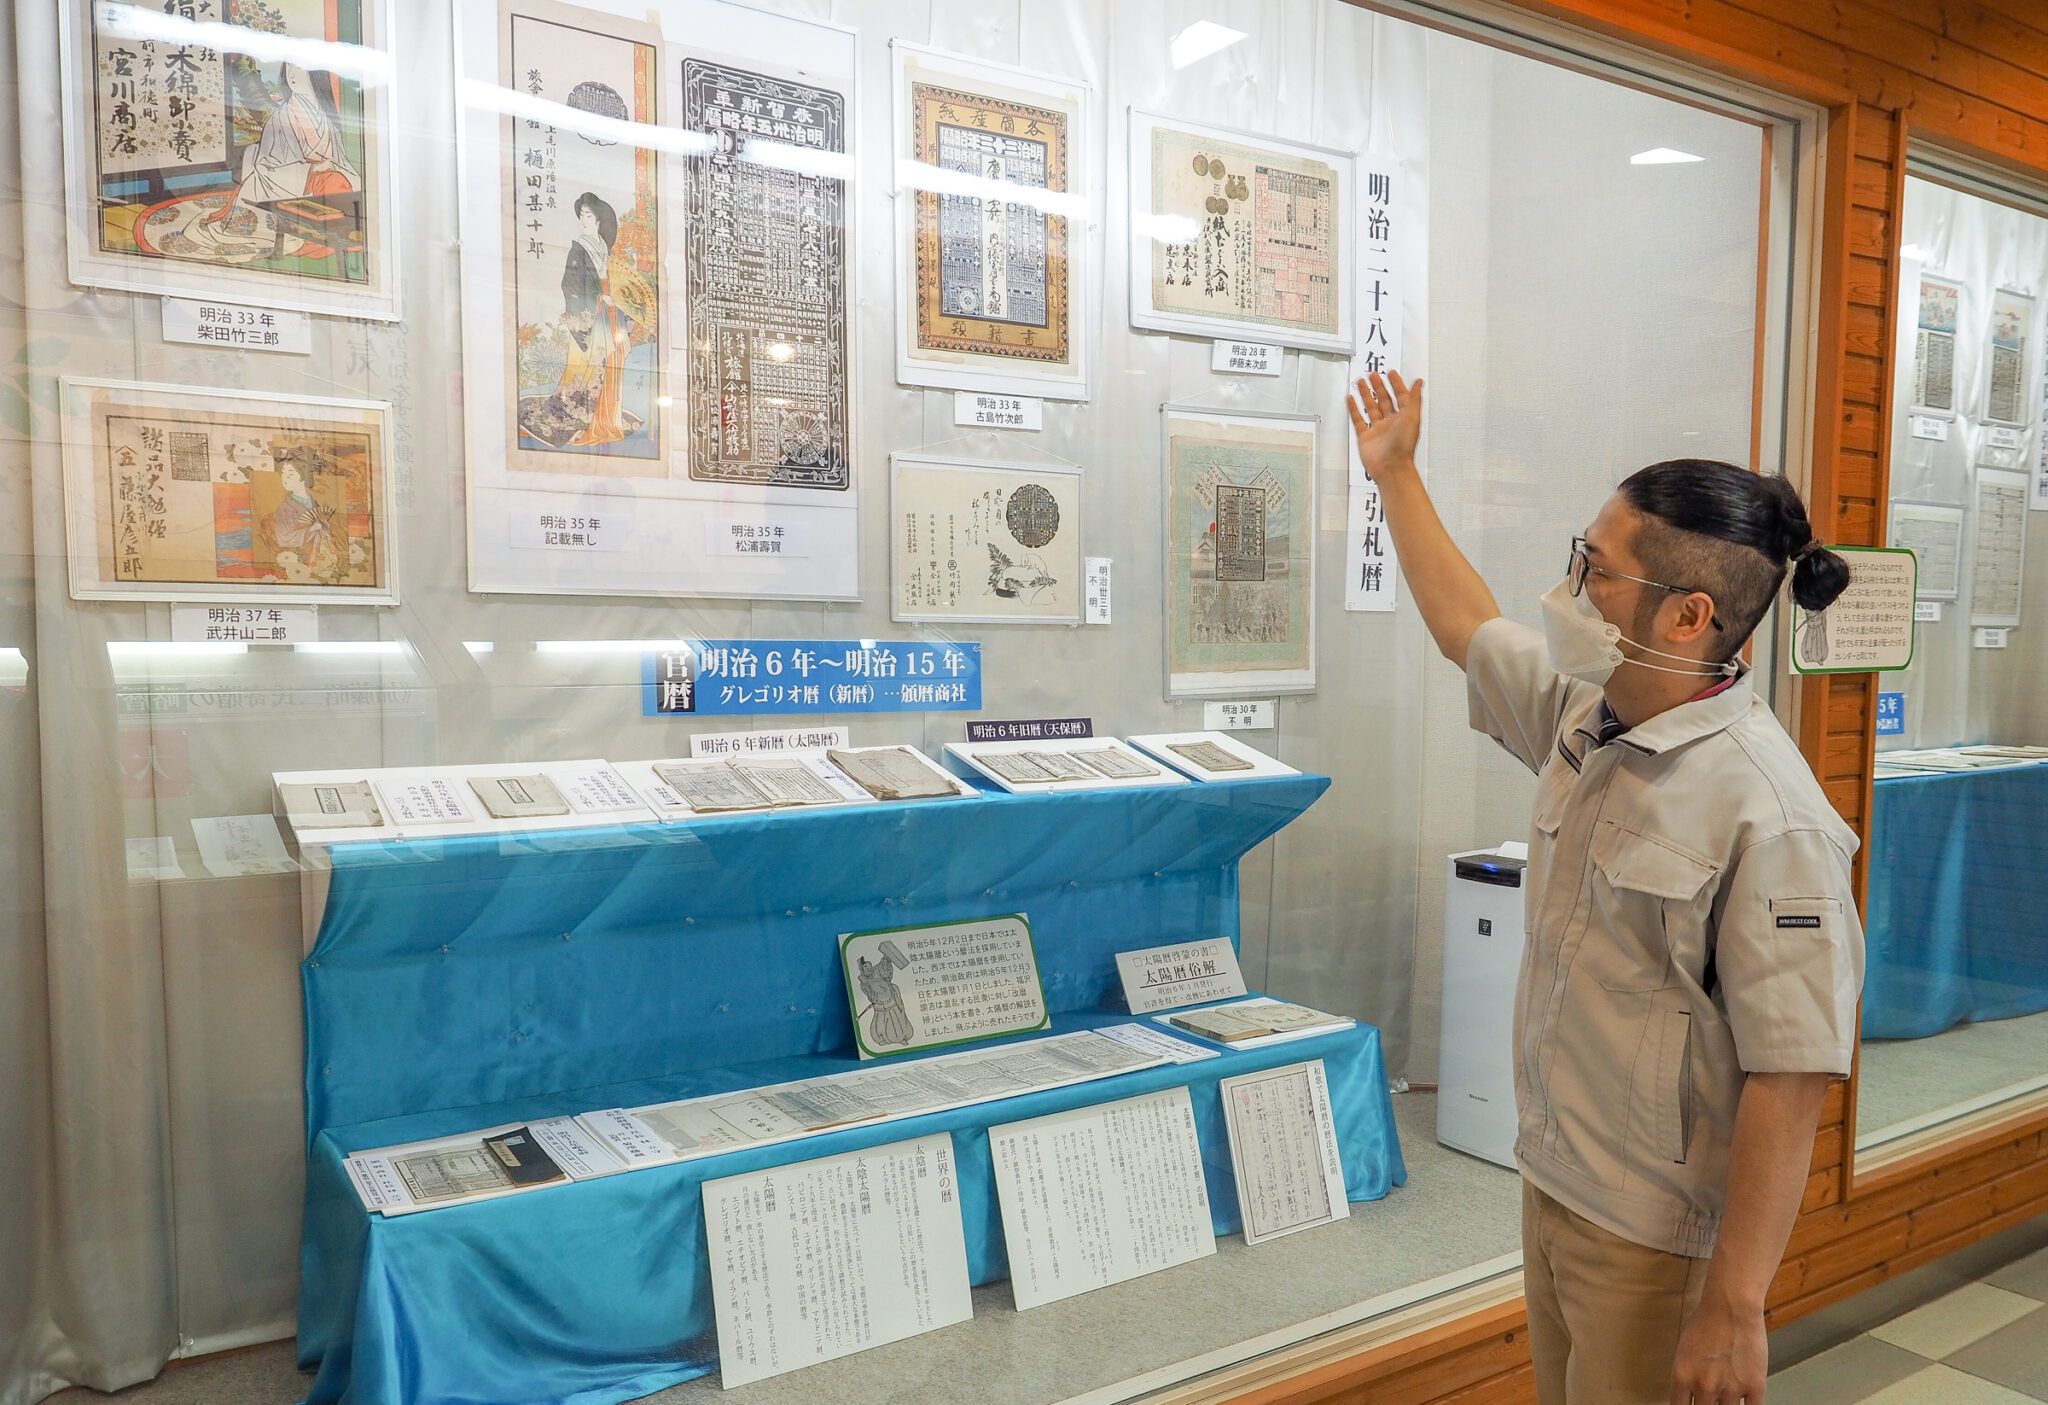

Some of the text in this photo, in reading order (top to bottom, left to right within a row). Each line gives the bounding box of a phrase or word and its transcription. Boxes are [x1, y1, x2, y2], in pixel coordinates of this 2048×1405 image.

[198, 325, 279, 346] 柴田竹三郎
[976, 412, 1023, 425] 古島竹次郎
[545, 532, 597, 546] 記載無し
[206, 626, 286, 641] 武井山二郎
[1143, 960, 1216, 985] 太陽暦俗解
[915, 1144, 927, 1178] 太陰暦
[856, 1157, 871, 1215] 太陰太陽暦
[936, 1148, 952, 1203] 世界の暦
[763, 1176, 776, 1212] 太陽暦
